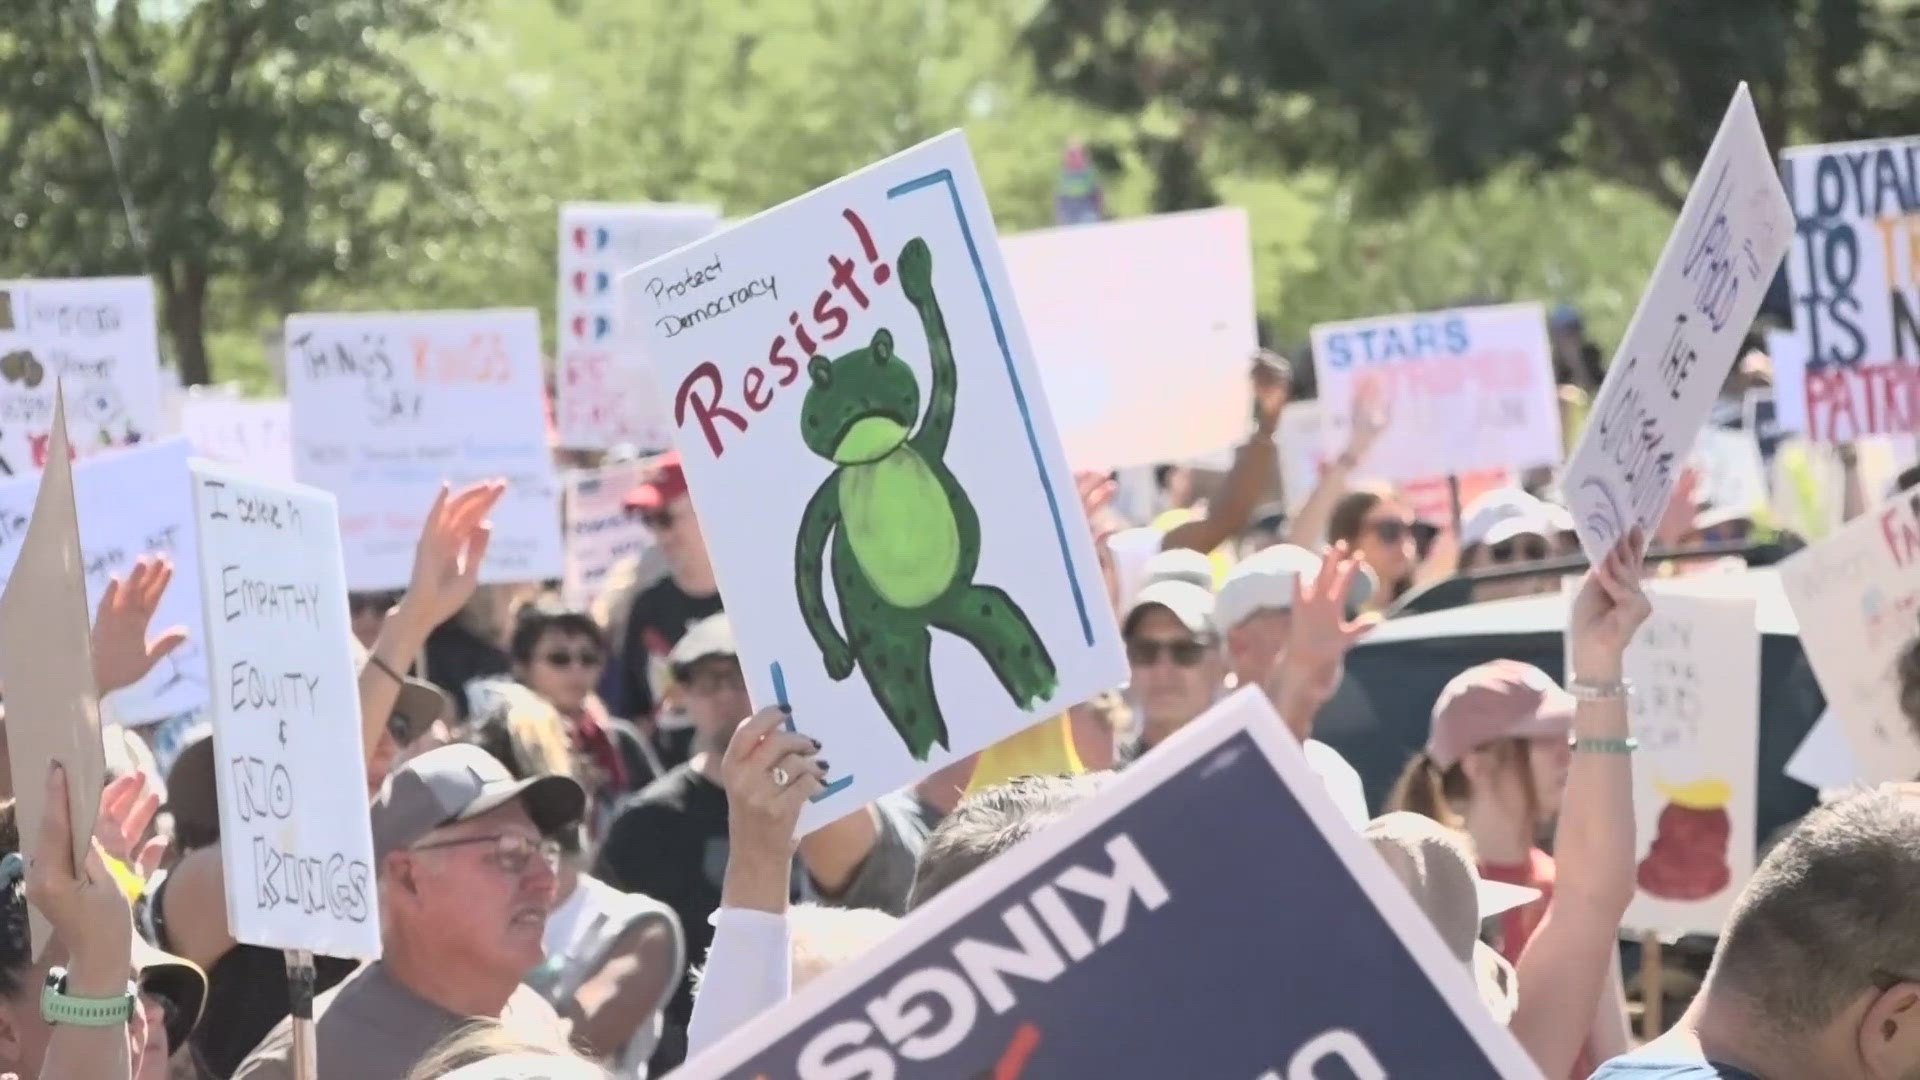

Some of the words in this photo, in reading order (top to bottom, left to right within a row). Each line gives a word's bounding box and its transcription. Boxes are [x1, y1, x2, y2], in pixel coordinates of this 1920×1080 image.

[645, 252, 724, 305] Protect
[1796, 217, 1858, 292] TO
[655, 275, 778, 338] Democracy
[674, 207, 891, 458] Resist!
[1799, 295, 1867, 368] IS
[1327, 314, 1470, 368] STARS
[1657, 314, 1697, 399] THE
[203, 479, 229, 521] I
[222, 564, 320, 632] EMPATHY
[231, 660, 319, 716] EQUITY
[231, 755, 294, 823] NO
[252, 836, 369, 924] KINGS
[797, 832, 1171, 1080] KINGS
